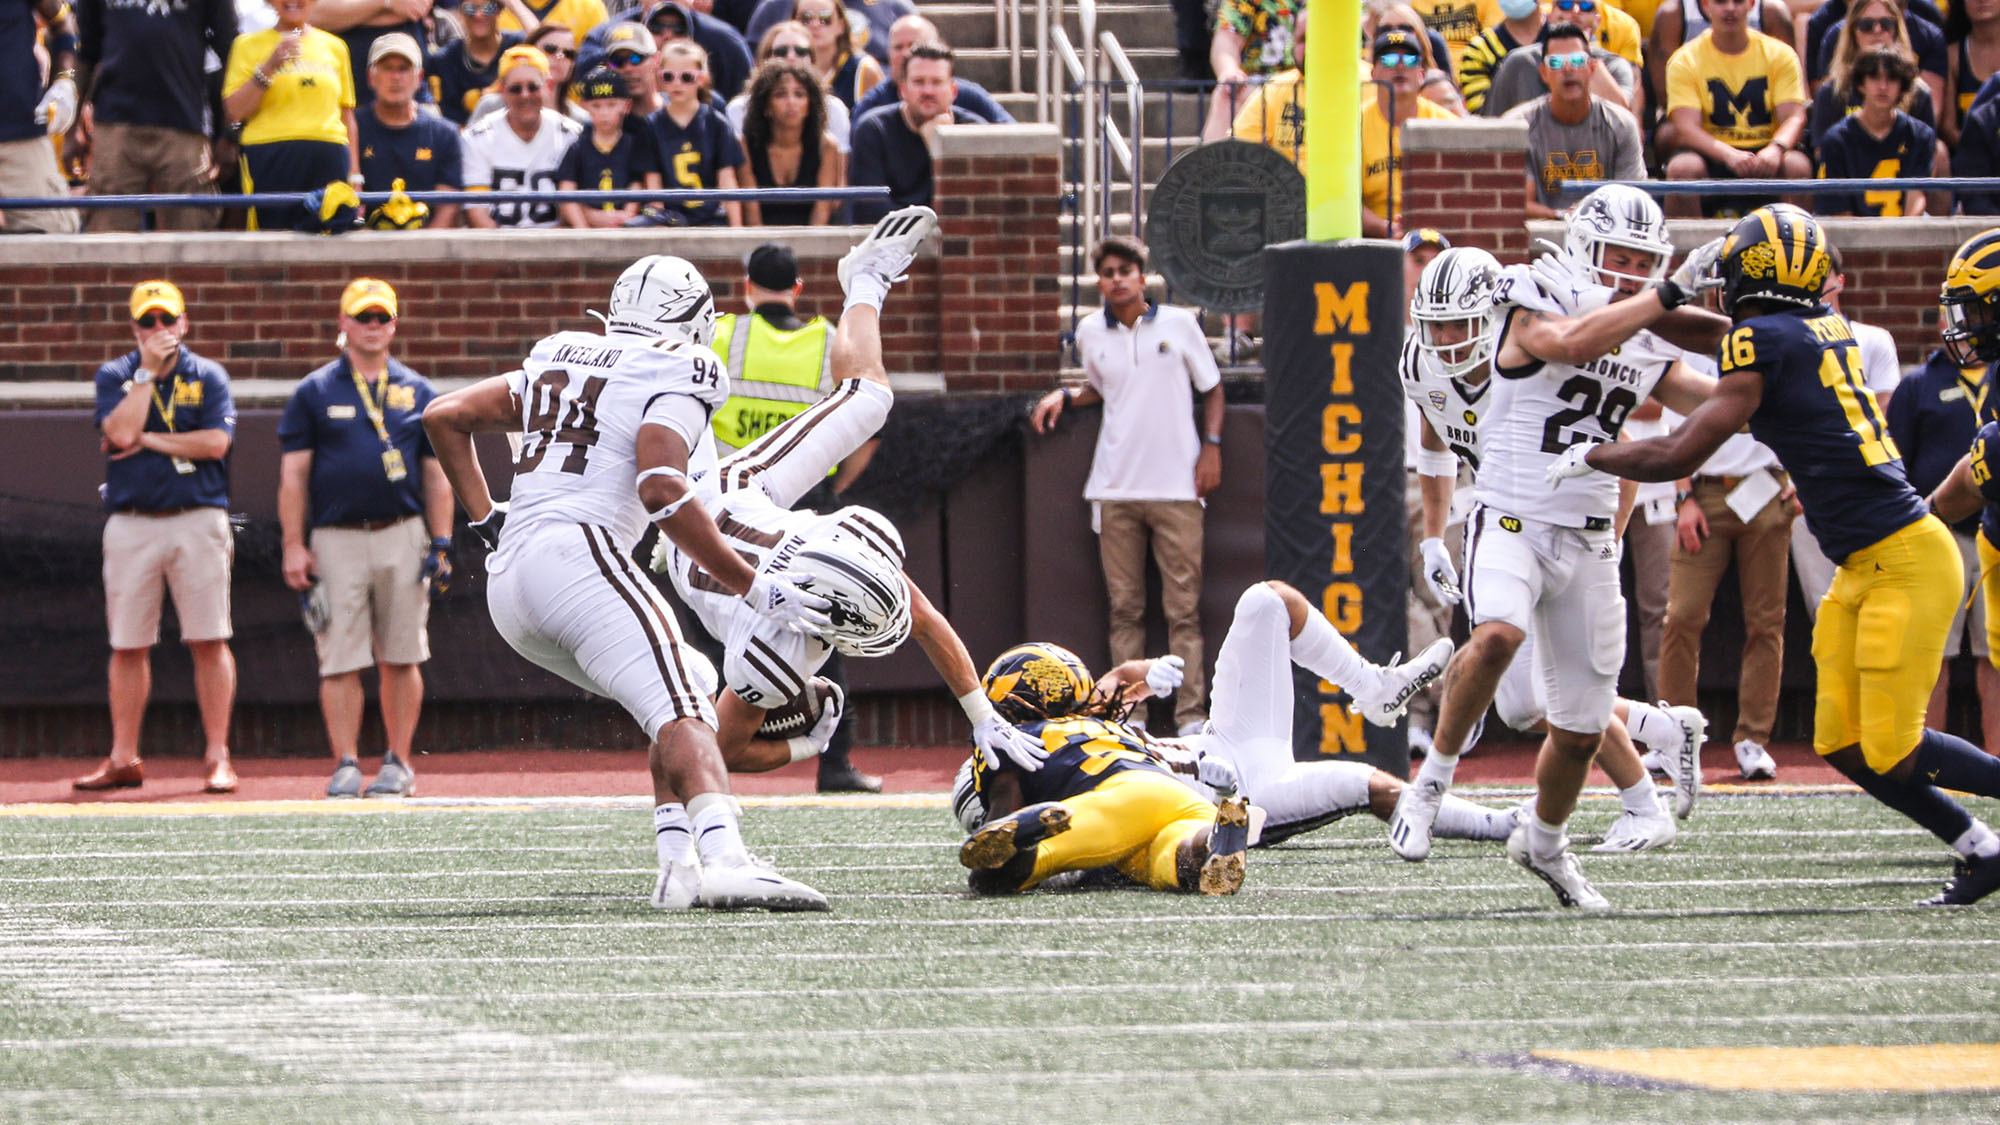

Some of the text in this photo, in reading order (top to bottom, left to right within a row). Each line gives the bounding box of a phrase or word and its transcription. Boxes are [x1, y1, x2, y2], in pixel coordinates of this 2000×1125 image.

[1706, 75, 1771, 127] M
[673, 151, 704, 208] 5
[1491, 277, 1515, 306] 29
[552, 344, 623, 369] KNEELAND
[1721, 326, 1756, 372] 16
[691, 356, 719, 389] 94
[514, 369, 609, 476] 94
[736, 408, 797, 438] SHER
[1540, 374, 1638, 456] 29
[1313, 281, 1371, 753] MICHIGN
[1501, 517, 1519, 531] W
[734, 682, 765, 705] 19
